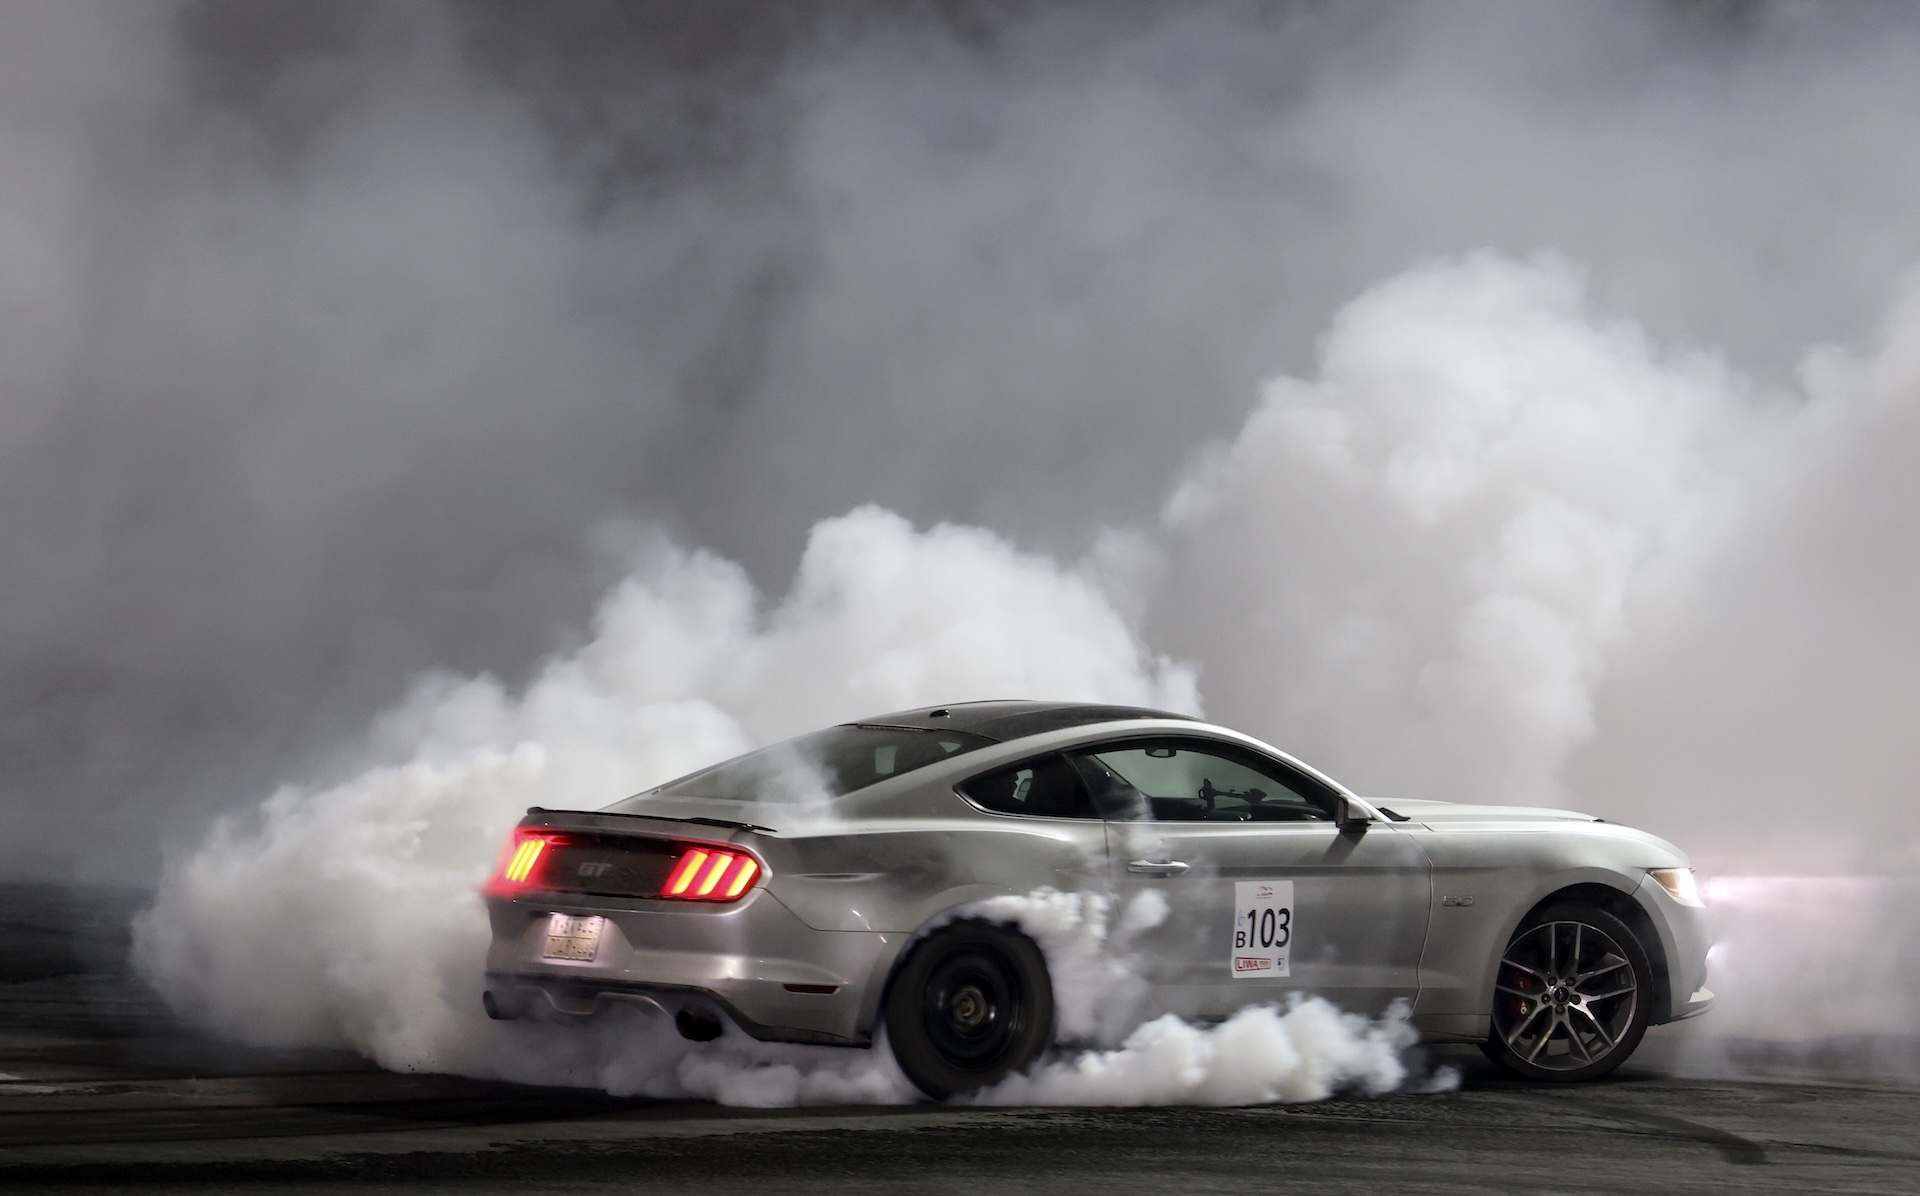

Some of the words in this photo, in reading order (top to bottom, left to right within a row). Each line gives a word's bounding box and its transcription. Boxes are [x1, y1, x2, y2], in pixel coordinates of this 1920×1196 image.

[578, 862, 612, 877] GT
[1443, 895, 1473, 907] 5.0
[1247, 907, 1291, 948] 103
[1237, 959, 1259, 969] LIWA
